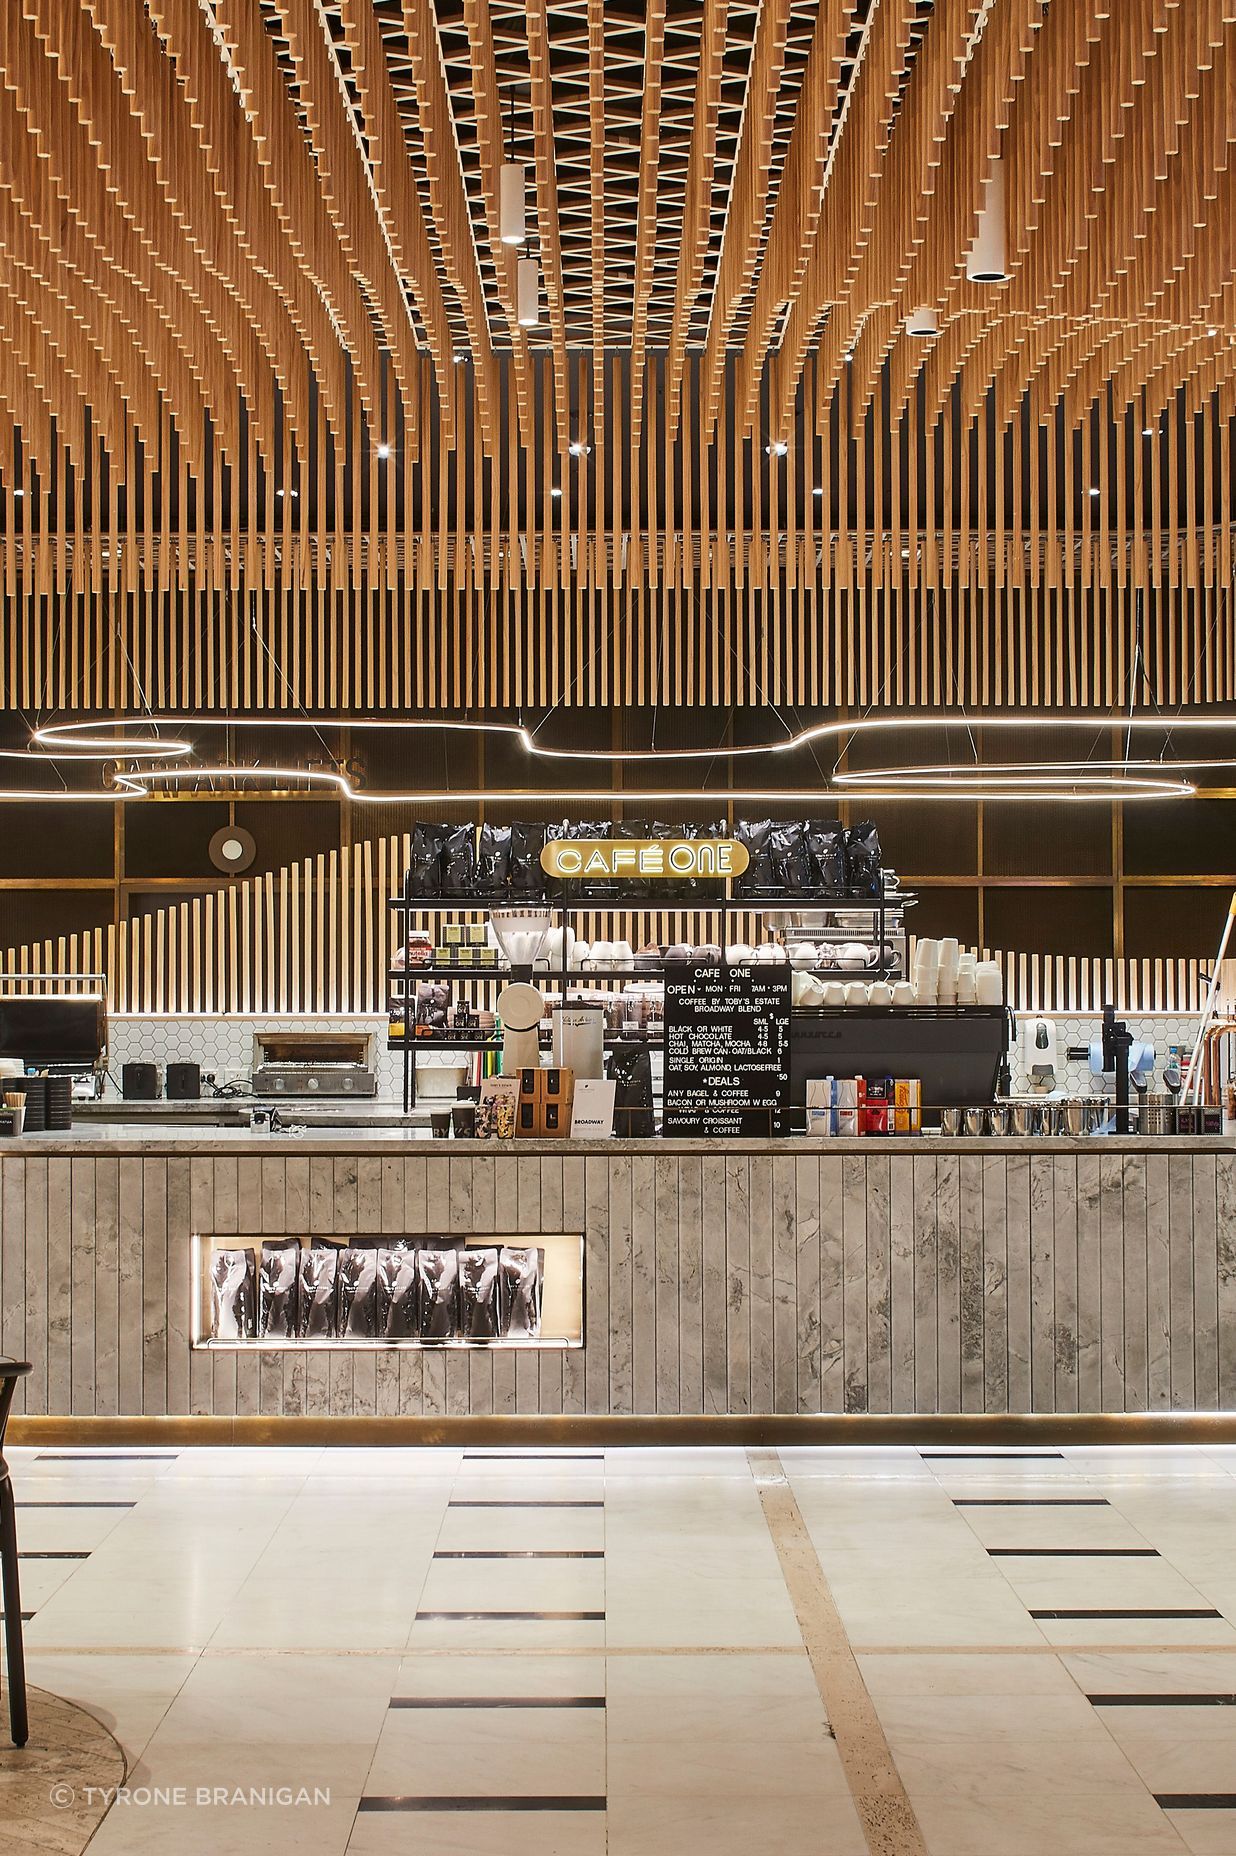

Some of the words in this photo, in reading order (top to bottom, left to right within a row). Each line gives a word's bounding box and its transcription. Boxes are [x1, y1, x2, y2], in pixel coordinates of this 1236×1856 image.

[557, 844, 664, 873] CAFÉ
[669, 846, 733, 873] ONE
[694, 968, 721, 978] CAFE
[729, 968, 751, 978] ONE
[666, 985, 696, 995] OPEN
[705, 985, 723, 993] MON
[729, 985, 741, 993] FRI
[772, 985, 788, 993] 3PM
[678, 998, 707, 1006] COFFEE
[711, 998, 721, 1006] BY
[725, 998, 751, 1006] TOBY'S
[754, 998, 781, 1006] ESTATE
[694, 1005, 735, 1013] BROADWAY
[738, 1005, 762, 1013] BLEND
[668, 1025, 693, 1033] BLACK
[696, 1025, 708, 1033] OR
[710, 1025, 733, 1033] WHITE
[778, 1025, 784, 1033] 5
[724, 1040, 751, 1048] MOCHA
[668, 1047, 689, 1055] COLD
[692, 1047, 712, 1055] BREW
[777, 1047, 783, 1055] 6
[668, 1056, 695, 1064] SINGLE
[698, 1056, 724, 1064] ORIGIN
[667, 1089, 685, 1097] ANY
[686, 1089, 710, 1097] BAGEL
[713, 1089, 719, 1097] &
[721, 1089, 749, 1097] COFFEE
[775, 1089, 781, 1097] 9
[667, 1117, 701, 1125] SAVOURY
[702, 1117, 743, 1125] CROISSANT
[773, 1121, 781, 1129] 10
[703, 1126, 709, 1134] &
[712, 1126, 741, 1134] COFFEE
